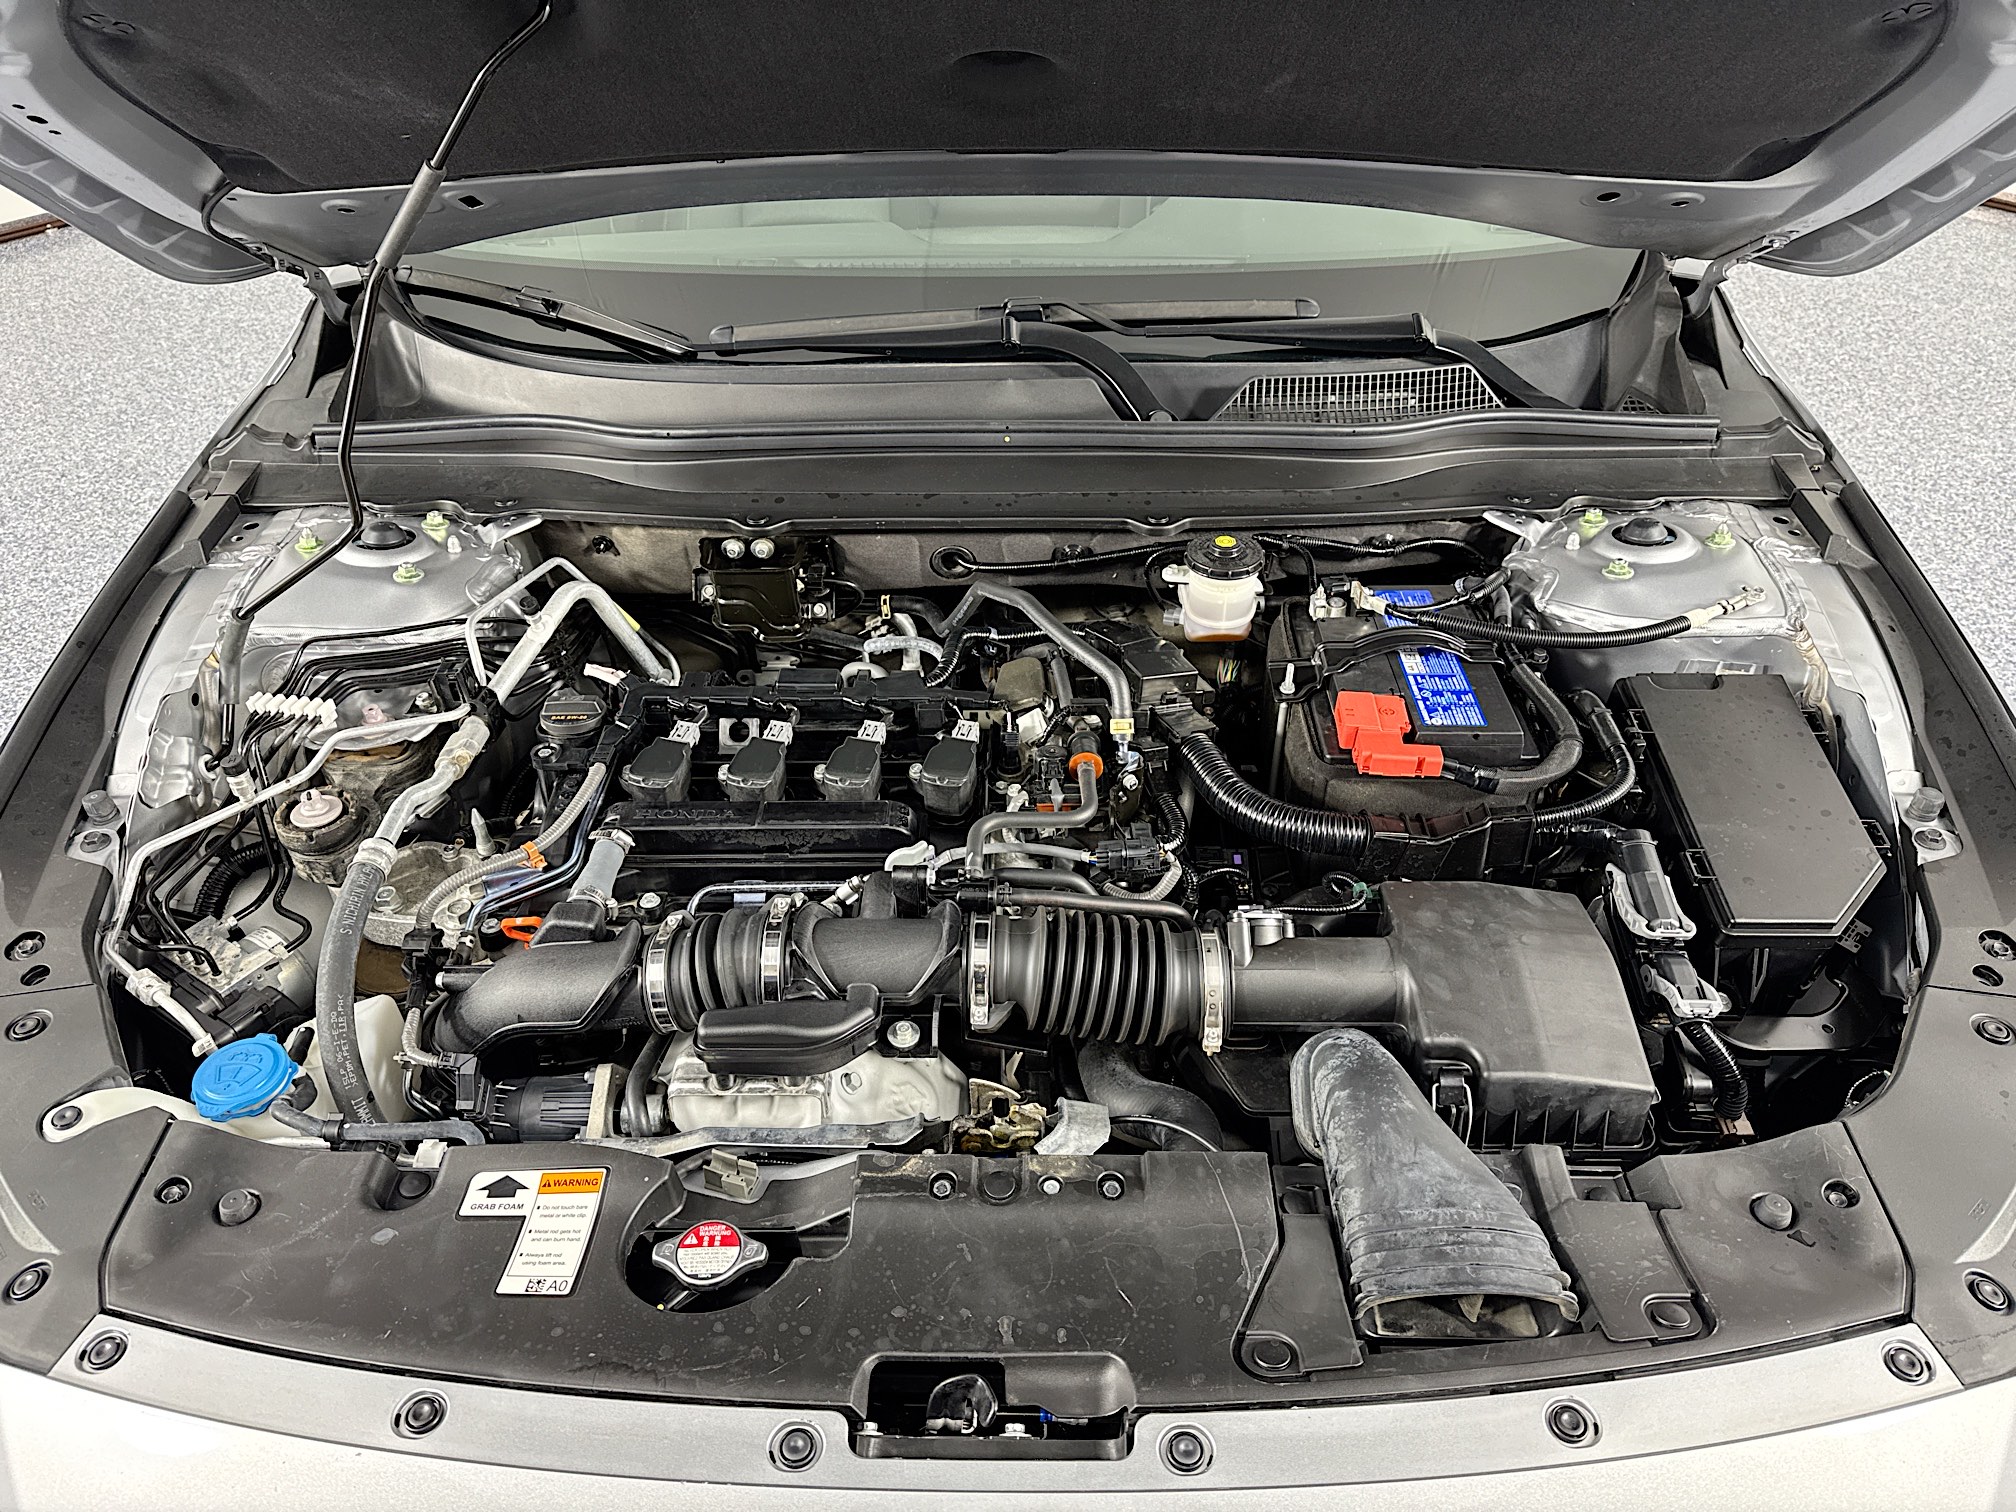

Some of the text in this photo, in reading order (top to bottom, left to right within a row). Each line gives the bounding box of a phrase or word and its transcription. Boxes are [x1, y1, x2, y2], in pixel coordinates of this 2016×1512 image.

[633, 809, 741, 820] HONDA
[553, 1178, 599, 1187] WARNING
[546, 1280, 568, 1291] A0
